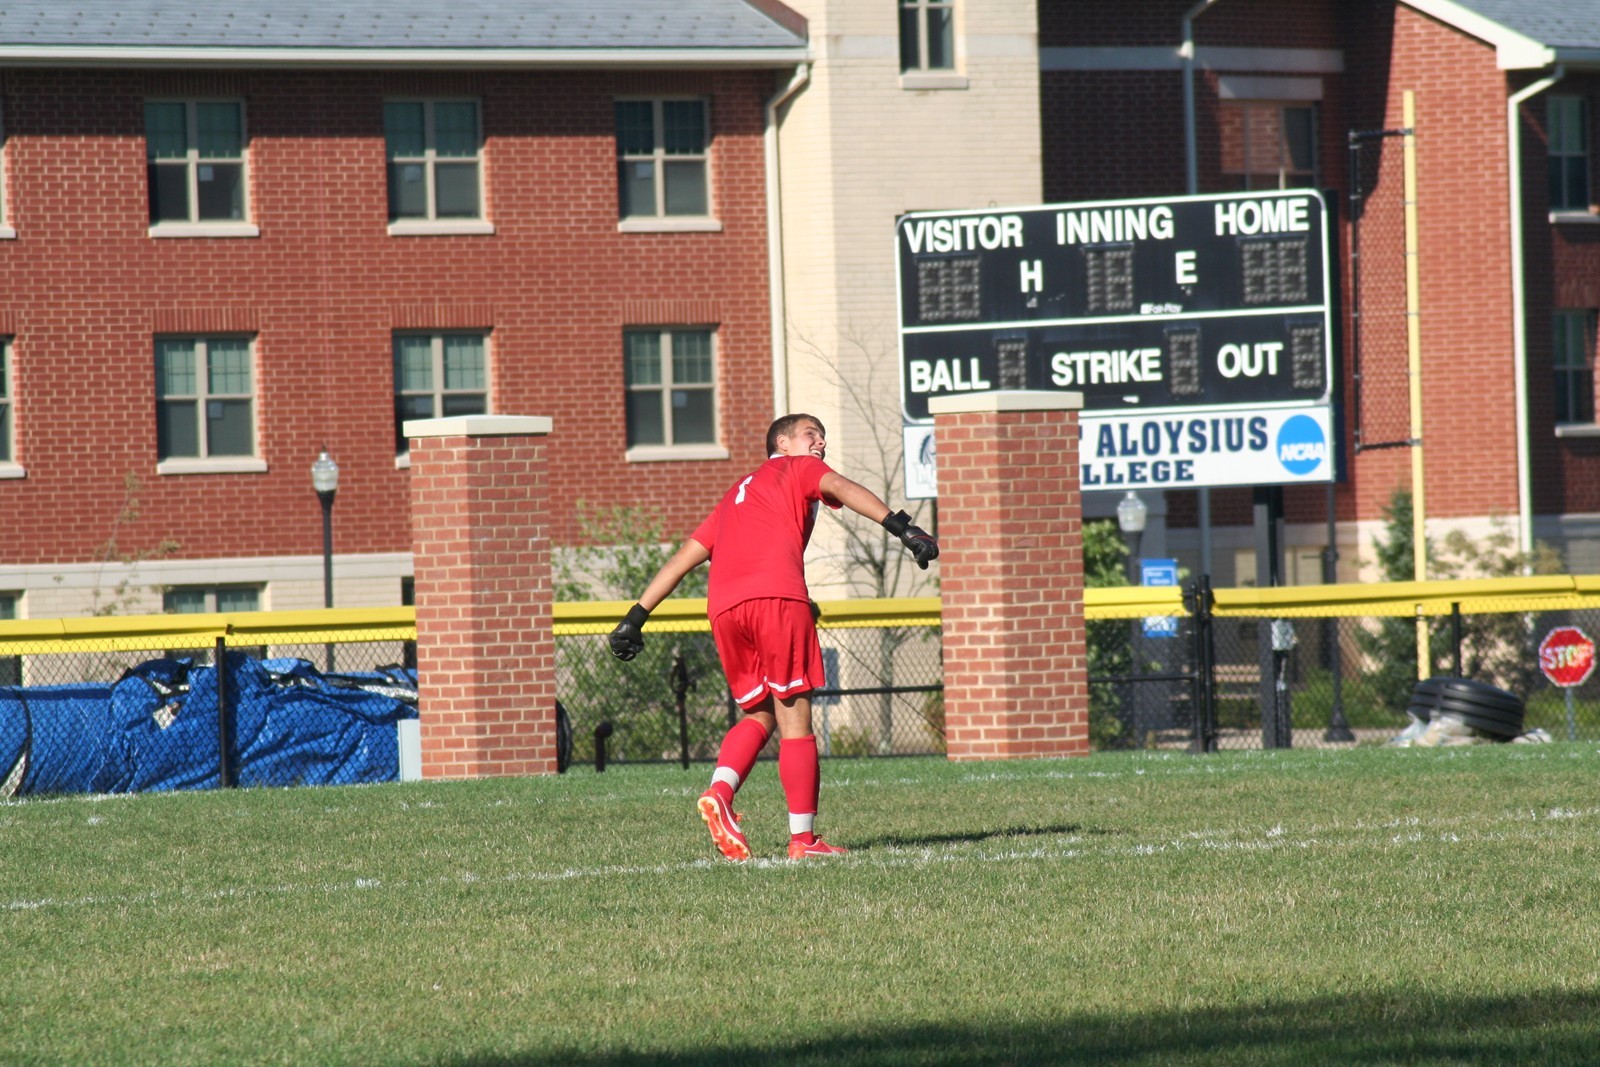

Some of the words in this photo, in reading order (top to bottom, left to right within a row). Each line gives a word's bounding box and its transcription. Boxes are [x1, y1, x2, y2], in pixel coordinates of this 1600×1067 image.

[903, 214, 1024, 254] VISITOR
[1056, 205, 1175, 246] INNING
[1214, 197, 1310, 236] HOME
[1019, 259, 1043, 293] H
[1175, 250, 1198, 285] E
[909, 357, 991, 393] BALL
[1051, 347, 1163, 387] STRIKE
[1216, 342, 1284, 379] OUT
[1096, 416, 1269, 458] ALOYSIUS
[1280, 442, 1325, 462] NCAA
[1081, 459, 1194, 486] LLEGE
[1544, 643, 1590, 670] STOP
